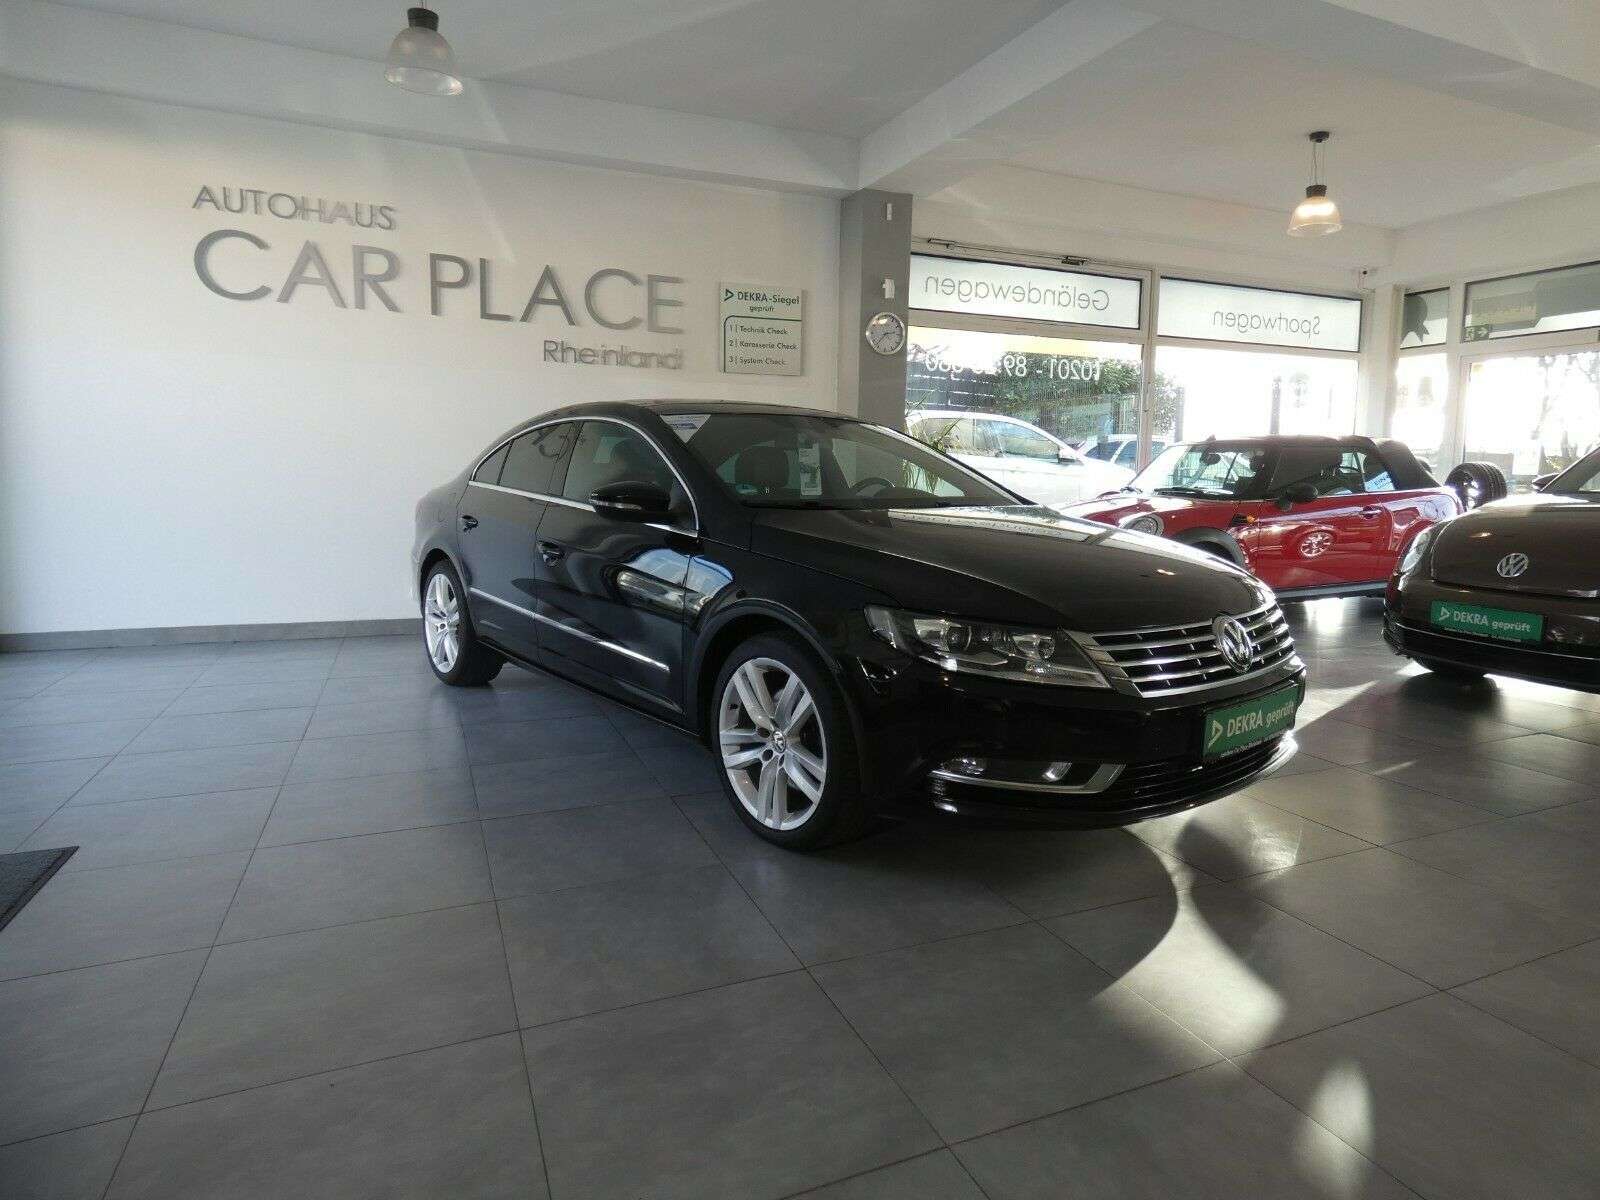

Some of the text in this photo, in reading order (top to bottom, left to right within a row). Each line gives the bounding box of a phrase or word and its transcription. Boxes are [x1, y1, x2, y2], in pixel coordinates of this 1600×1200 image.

[192, 184, 397, 230] AUTOHAUS
[194, 229, 684, 335] CAR PLACE
[543, 339, 682, 370] Rheinland
[1453, 610, 1531, 633] DEKRA geprüft
[1226, 709, 1264, 738] DEKRA
